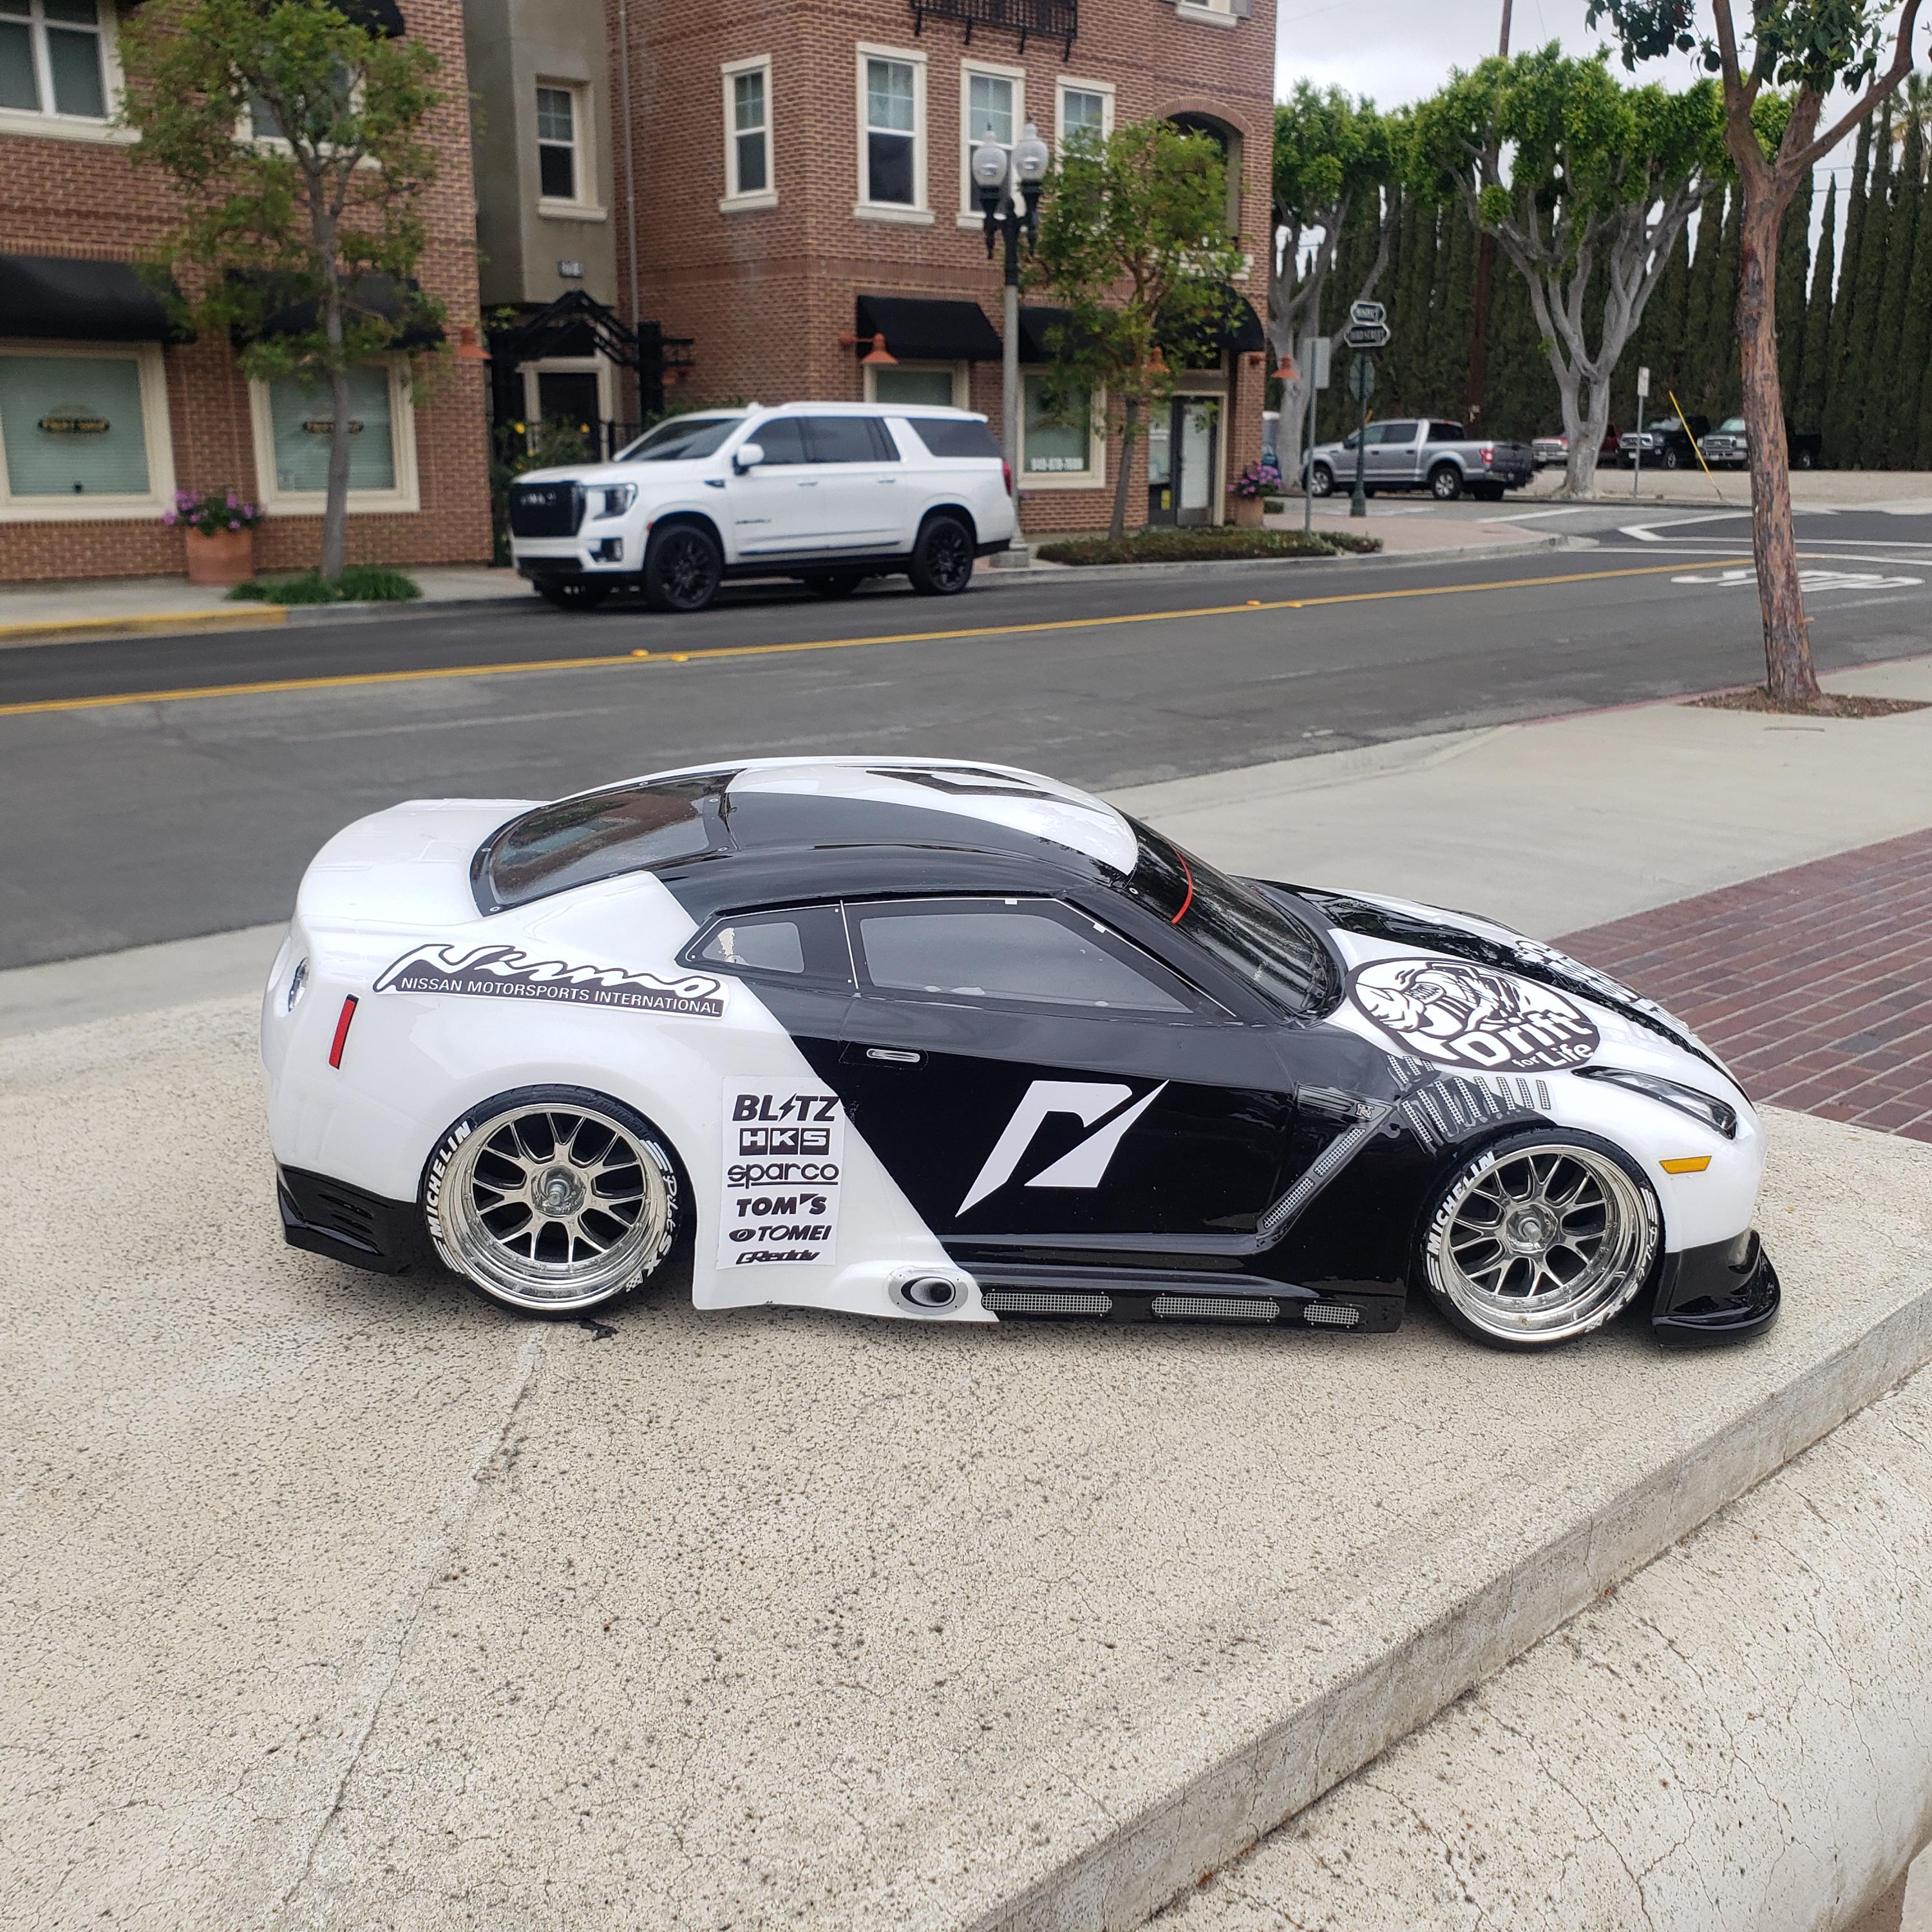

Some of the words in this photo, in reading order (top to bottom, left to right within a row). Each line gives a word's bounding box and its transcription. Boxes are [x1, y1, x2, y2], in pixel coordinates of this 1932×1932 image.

[401, 976, 462, 992] NISSAN
[468, 981, 590, 1001] MOTORSPORTS
[594, 990, 721, 1015] INTERNATIONAL
[1449, 1010, 1593, 1067] Drift
[1511, 1055, 1540, 1068] for
[1535, 1043, 1594, 1067] Life
[741, 1129, 829, 1150] HKS
[426, 1120, 471, 1238] MICHELIN
[727, 1162, 839, 1189] sparco
[737, 1193, 828, 1217] TOM'S
[1426, 1151, 1495, 1256] MICHELIN
[757, 1225, 832, 1241] TOMEI
